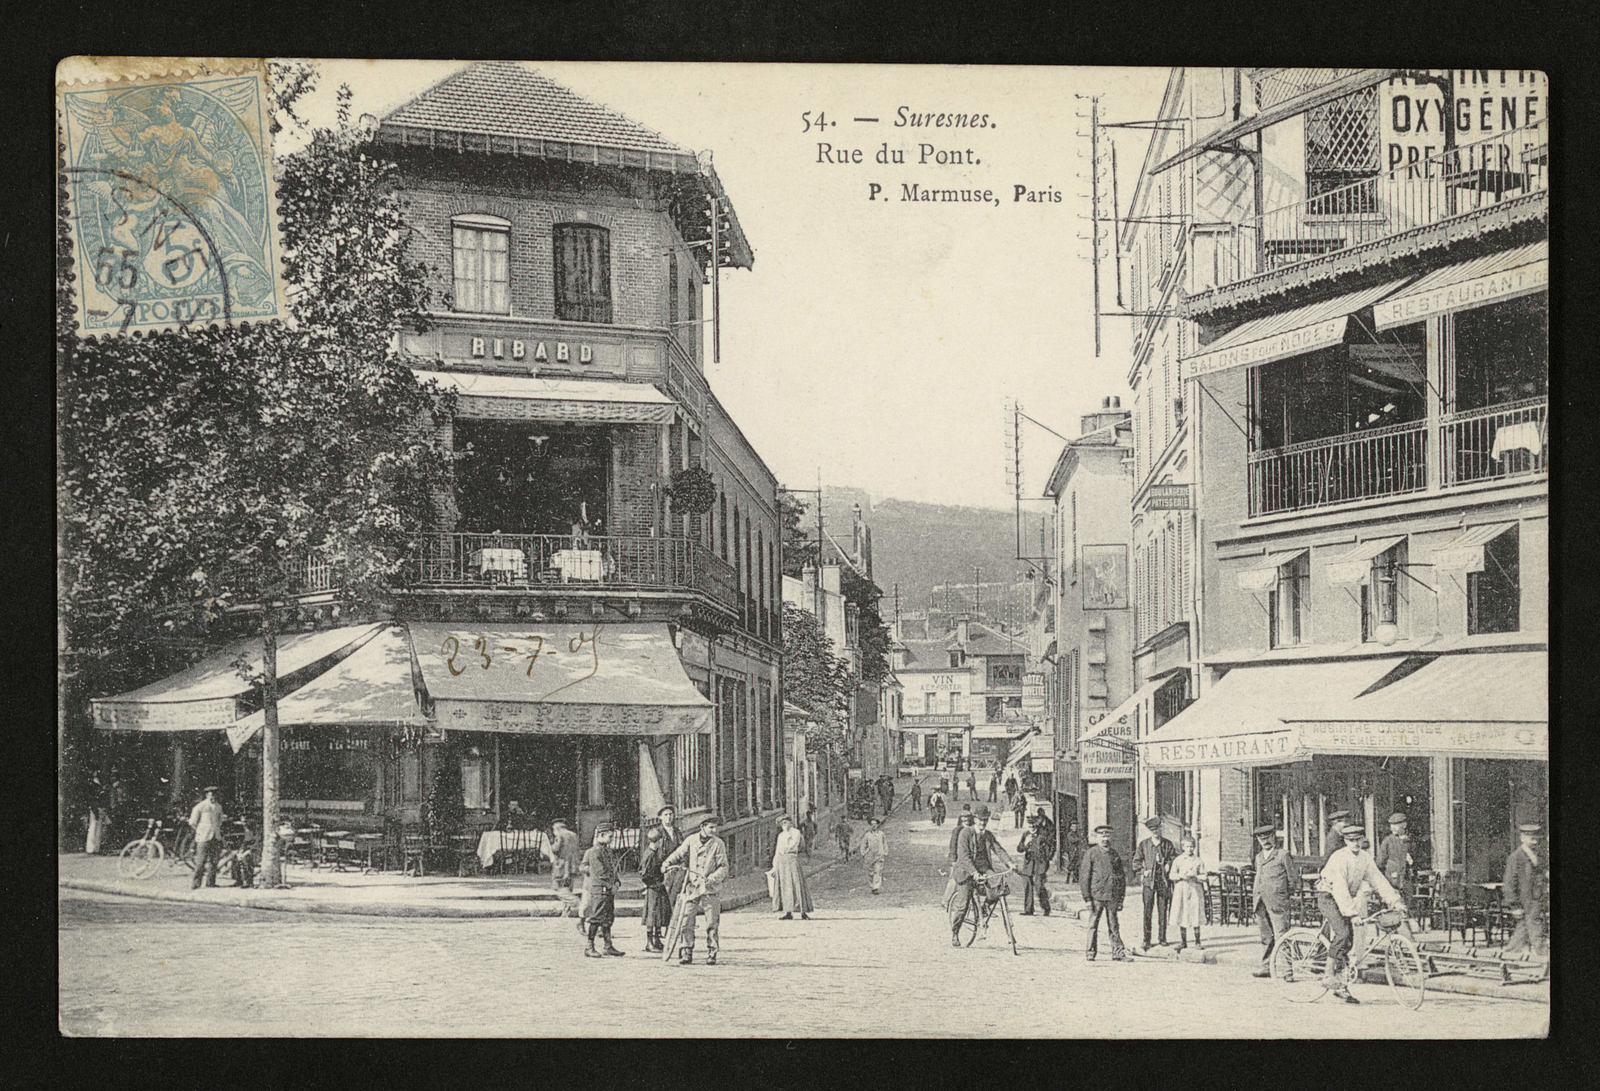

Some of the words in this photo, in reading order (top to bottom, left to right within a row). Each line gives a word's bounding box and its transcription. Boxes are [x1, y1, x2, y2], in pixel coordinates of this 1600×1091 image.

[1392, 90, 1548, 133] OXYGÉNÉ
[1392, 271, 1526, 319] RESTAURANT
[138, 297, 221, 323] POSTES
[472, 337, 592, 362] RIBARD
[1190, 349, 1249, 375] SALONS
[932, 675, 954, 684] VIN
[1088, 713, 1128, 726] CAE
[1160, 736, 1289, 761] RESTAURANT
